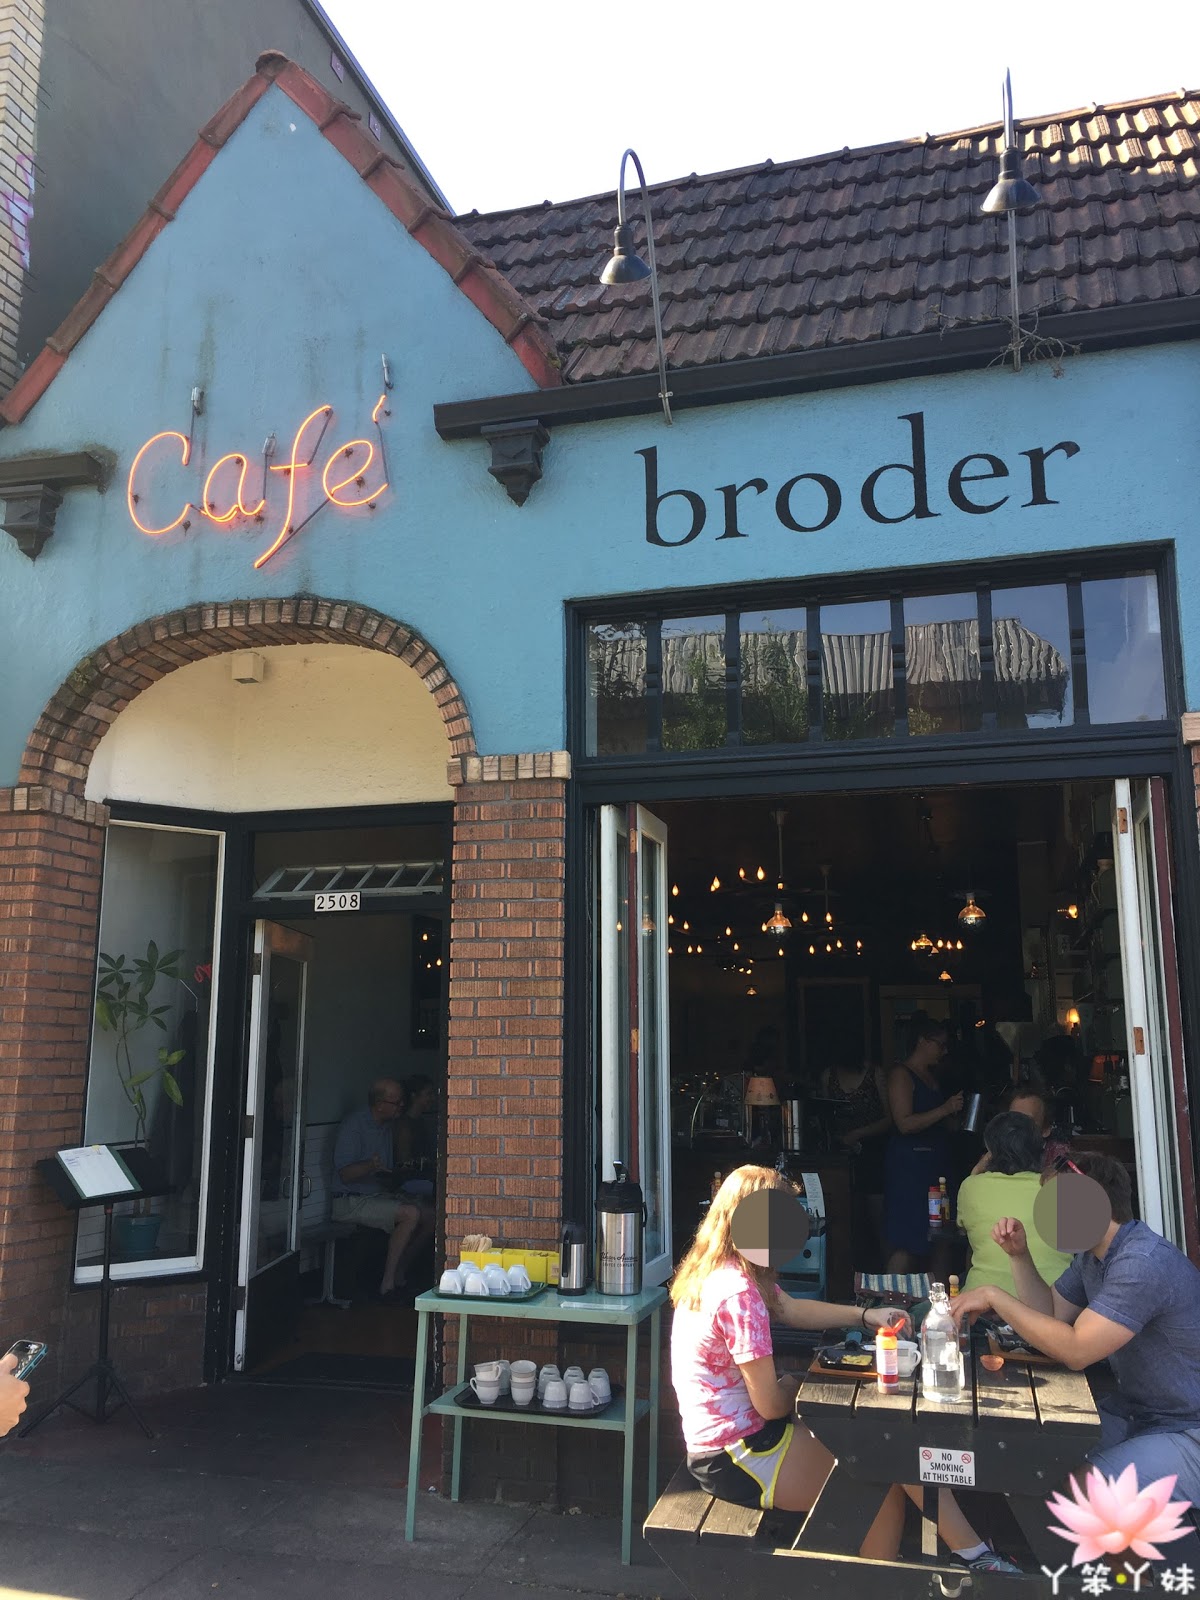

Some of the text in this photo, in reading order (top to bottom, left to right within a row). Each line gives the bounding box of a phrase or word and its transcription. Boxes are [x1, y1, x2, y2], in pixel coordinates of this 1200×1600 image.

[127, 394, 390, 569] Café
[633, 411, 1081, 548] broder
[316, 894, 358, 910] 2508
[941, 1452, 952, 1461] NO
[930, 1462, 964, 1473] SMOKING
[922, 1472, 973, 1484] AT THIS TABLE
